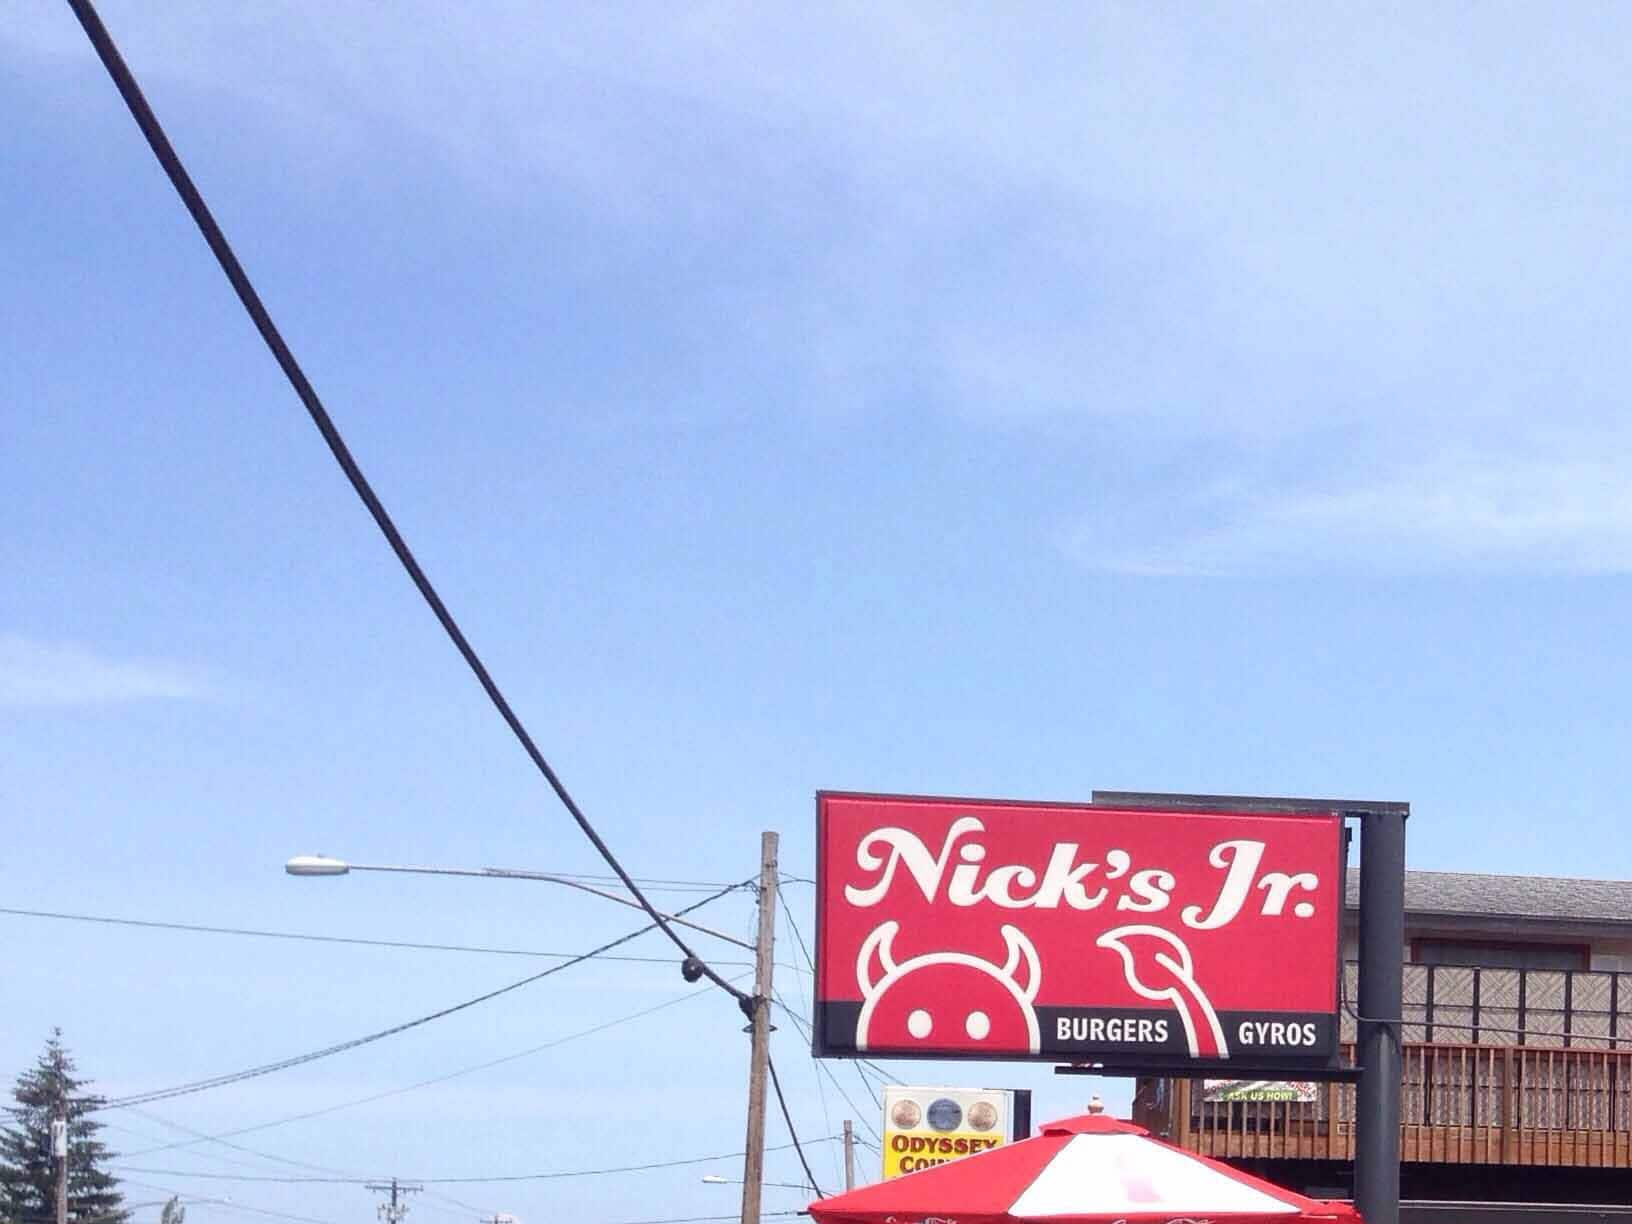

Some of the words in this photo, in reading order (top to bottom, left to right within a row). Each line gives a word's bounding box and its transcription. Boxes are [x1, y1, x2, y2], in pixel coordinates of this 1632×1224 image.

[845, 816, 1177, 913] Nick's
[1181, 839, 1320, 931] Jr.
[1056, 1017, 1169, 1043] BURGERS
[1238, 1021, 1317, 1046] GYROS
[1226, 1090, 1248, 1101] ASK
[1249, 1089, 1265, 1101] US
[891, 1134, 998, 1154] ODYSSEY
